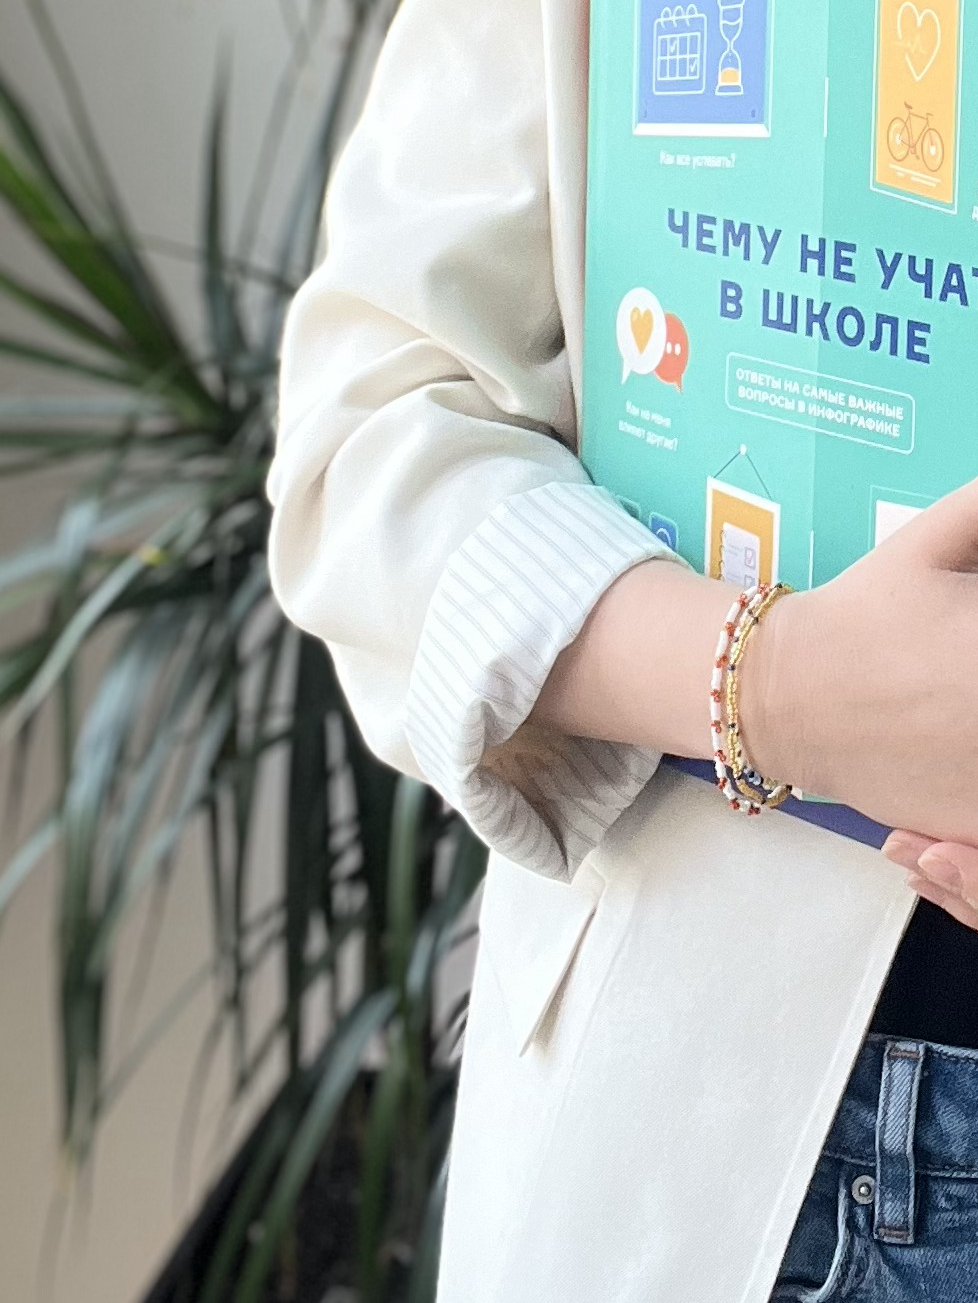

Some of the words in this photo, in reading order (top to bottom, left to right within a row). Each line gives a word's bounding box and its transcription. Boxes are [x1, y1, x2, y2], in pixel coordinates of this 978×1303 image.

[667, 207, 782, 265] ЧЕМУ
[799, 233, 857, 283] НЕ
[719, 279, 743, 320] В
[761, 288, 931, 364] ШКОЛЕ
[735, 367, 782, 387] ОТВЕТЫ
[783, 380, 801, 395] НА
[802, 383, 846, 407] САМЫЕ
[847, 395, 904, 421] ВАЖНЫЕ
[737, 385, 795, 411] ВОПРОСЫ
[797, 399, 806, 414] В
[807, 402, 900, 438] ИНФОГРАФИКЕ
